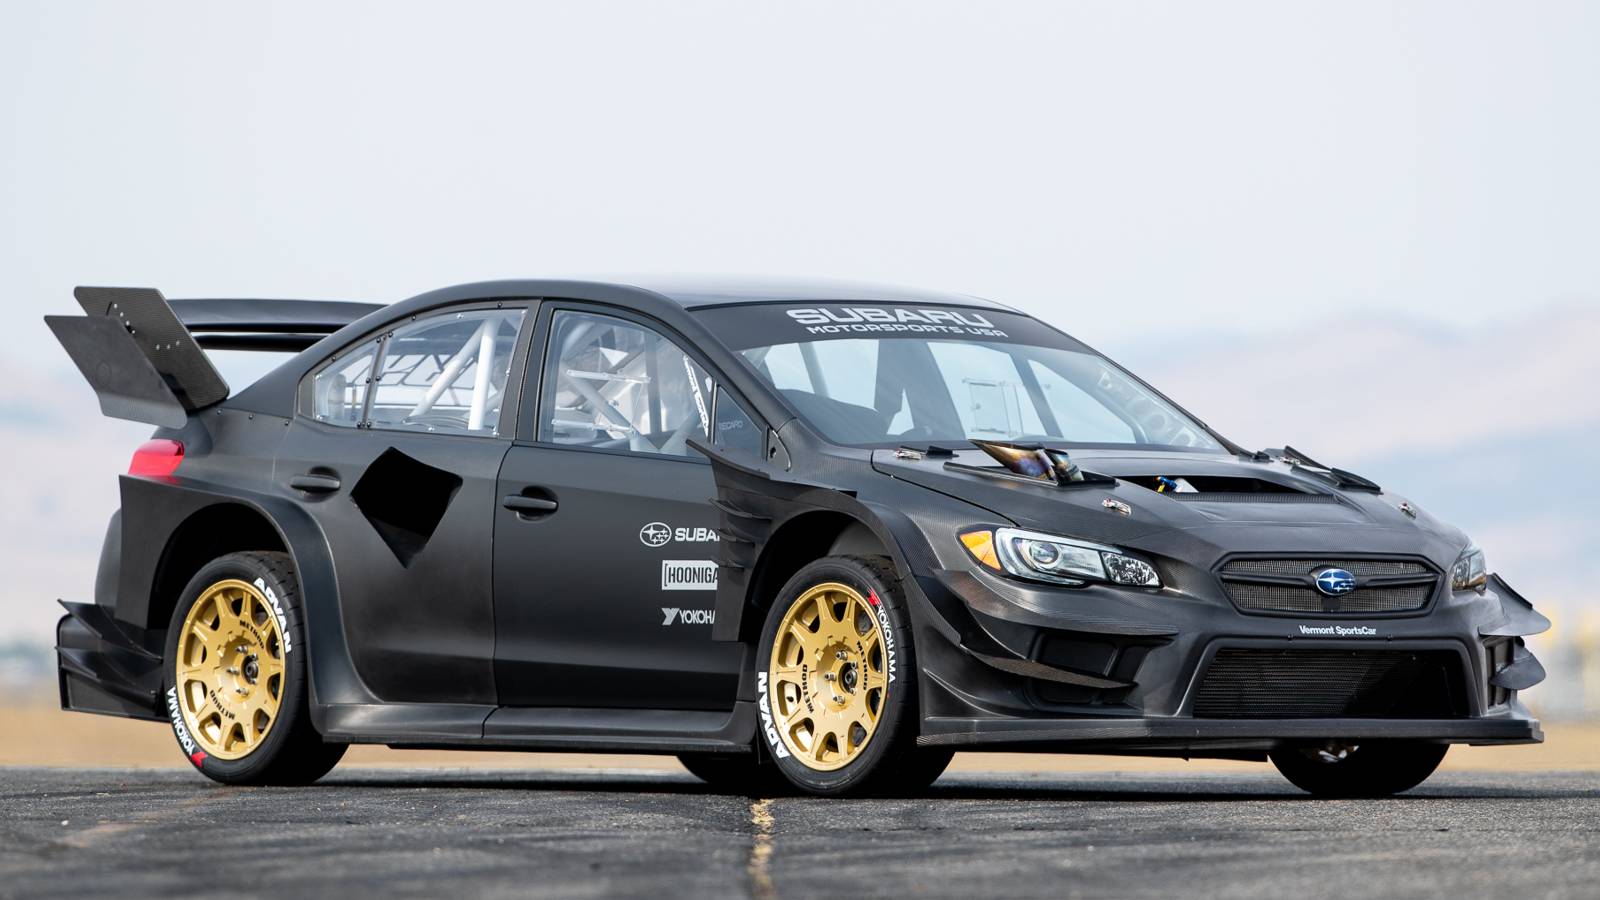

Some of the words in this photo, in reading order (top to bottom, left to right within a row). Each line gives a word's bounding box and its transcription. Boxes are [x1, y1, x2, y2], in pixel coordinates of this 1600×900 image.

[786, 307, 995, 329] SUBARU
[806, 323, 964, 334] MOTORSPORTS
[966, 327, 1009, 338] USA
[253, 577, 292, 653] ADVAN
[877, 605, 897, 684] YOKOHAMA
[1299, 625, 1335, 635] Vermont
[1335, 625, 1377, 636] SportsCar
[758, 671, 791, 759] ADVAN
[801, 664, 814, 714] METHOD
[167, 686, 196, 756] YOKOHAMA
